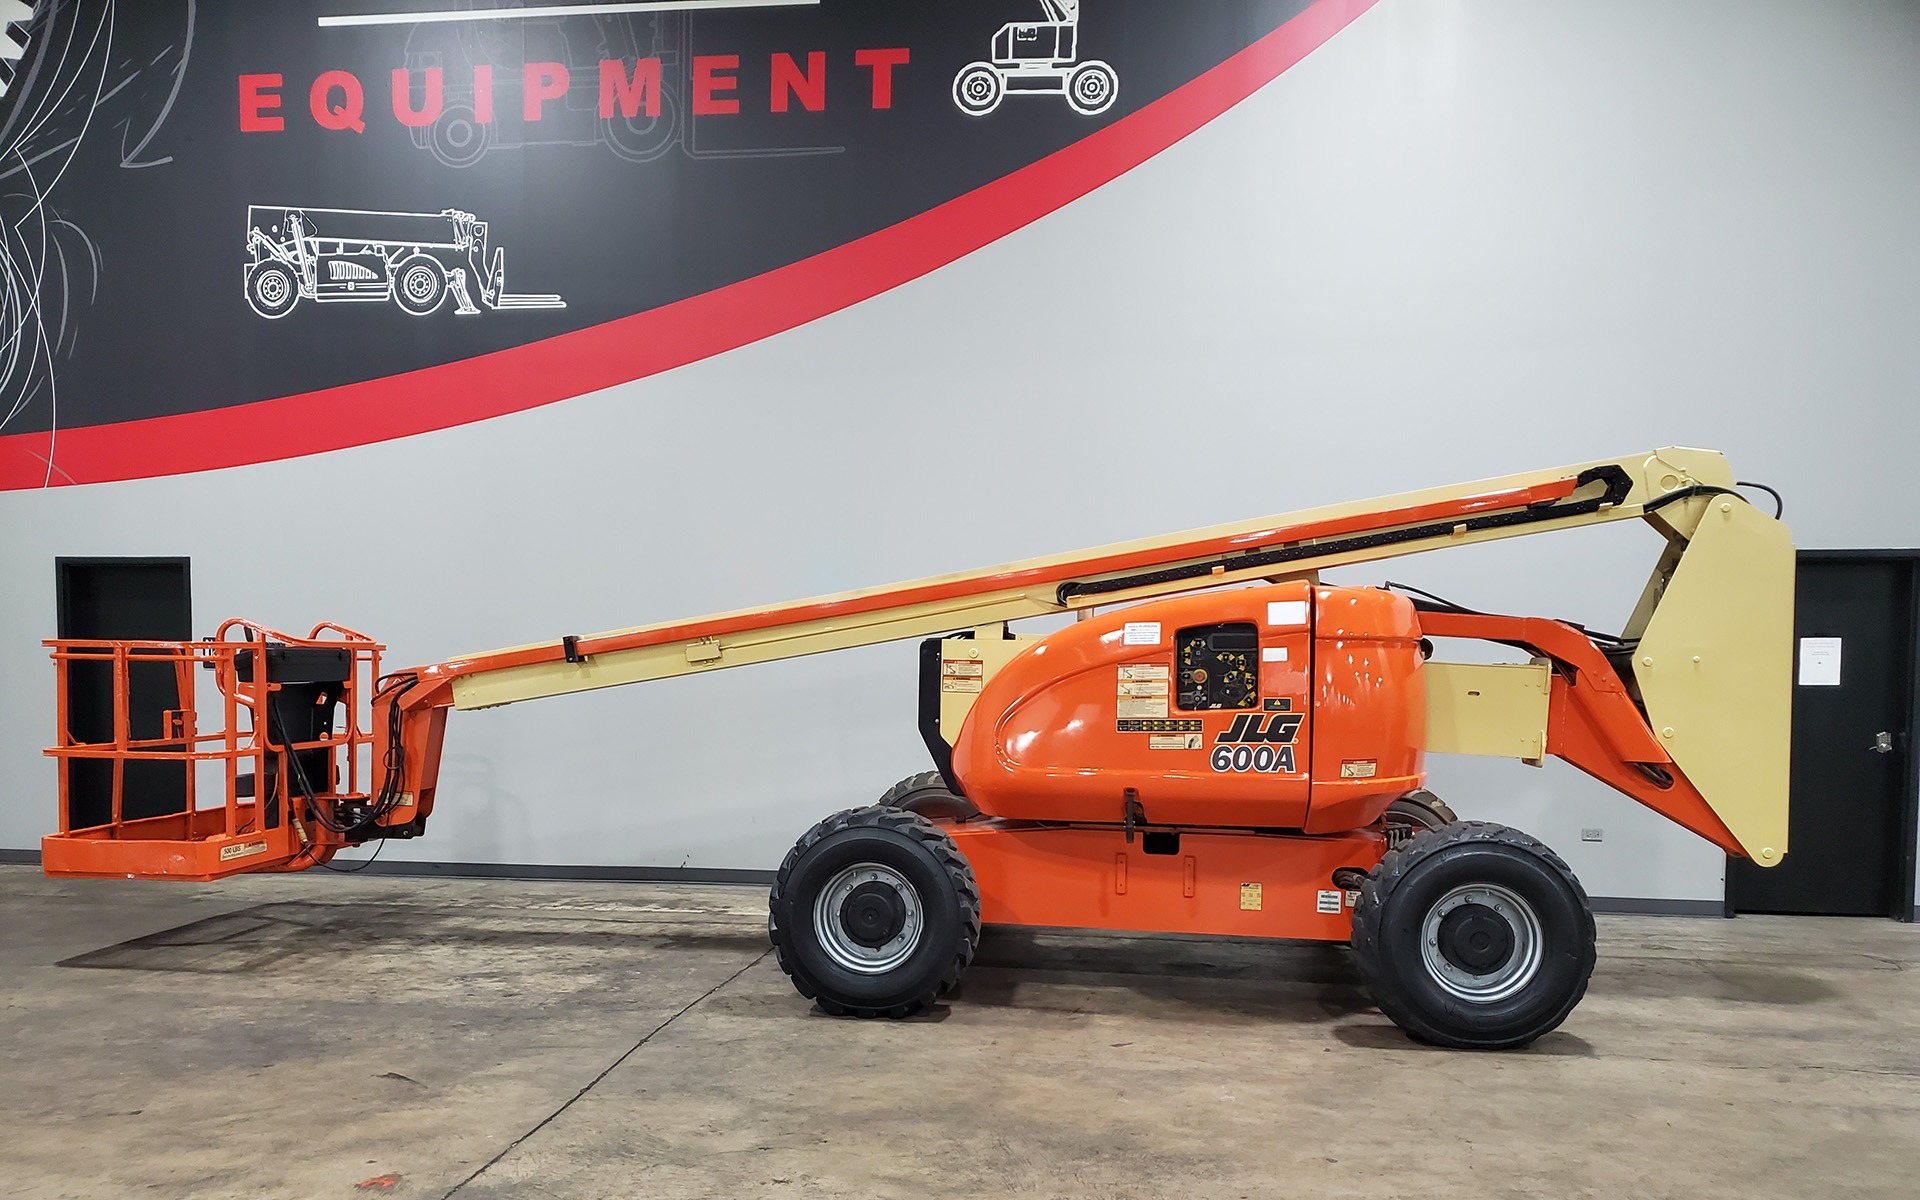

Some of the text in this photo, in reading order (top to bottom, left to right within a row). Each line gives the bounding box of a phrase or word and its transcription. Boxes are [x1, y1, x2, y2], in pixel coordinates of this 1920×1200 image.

[239, 48, 911, 134] EQUIPMENT
[1215, 714, 1304, 743] JLG
[1211, 745, 1296, 773] 600A
